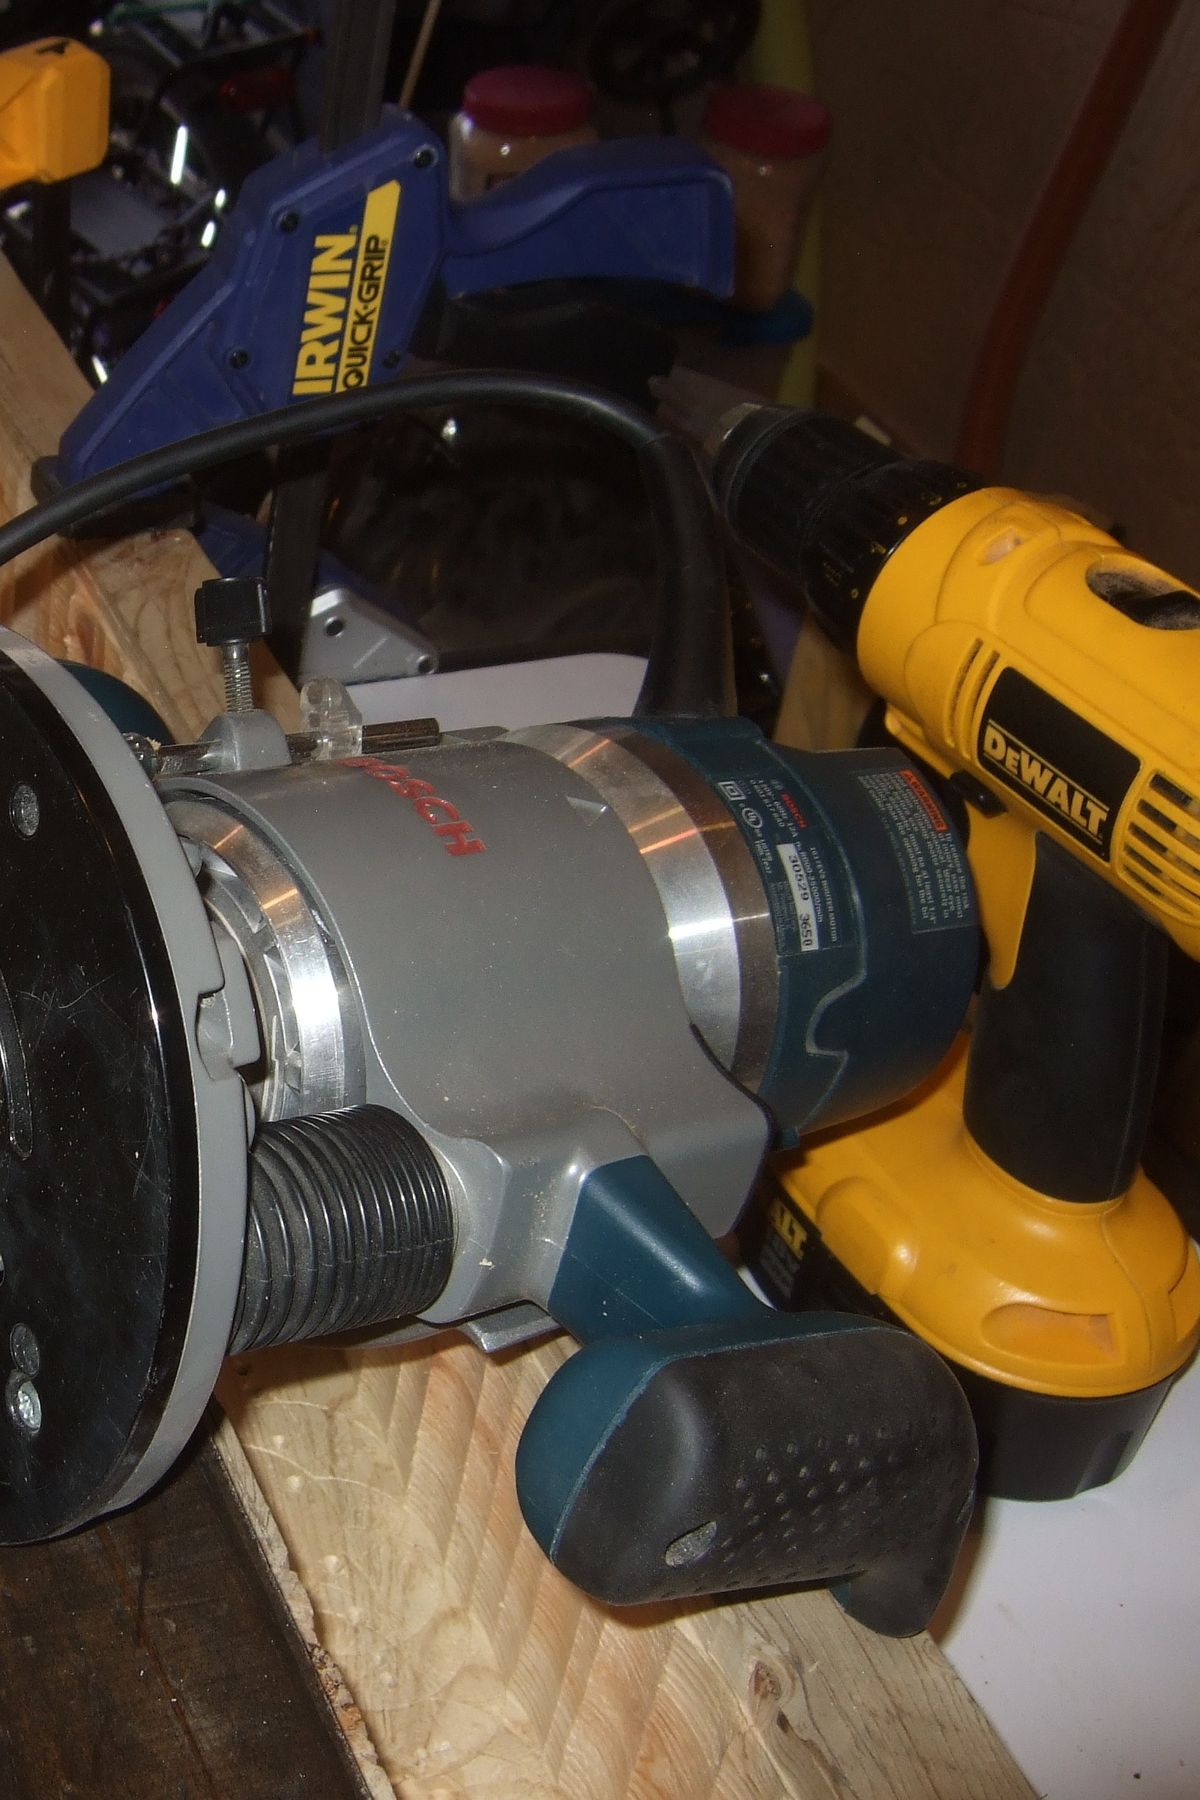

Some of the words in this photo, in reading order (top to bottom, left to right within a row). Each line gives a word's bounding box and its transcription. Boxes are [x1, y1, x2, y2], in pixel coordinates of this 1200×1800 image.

[292, 234, 357, 394] IRWIN
[780, 791, 809, 829] BOSCH
[786, 854, 811, 901] 30529
